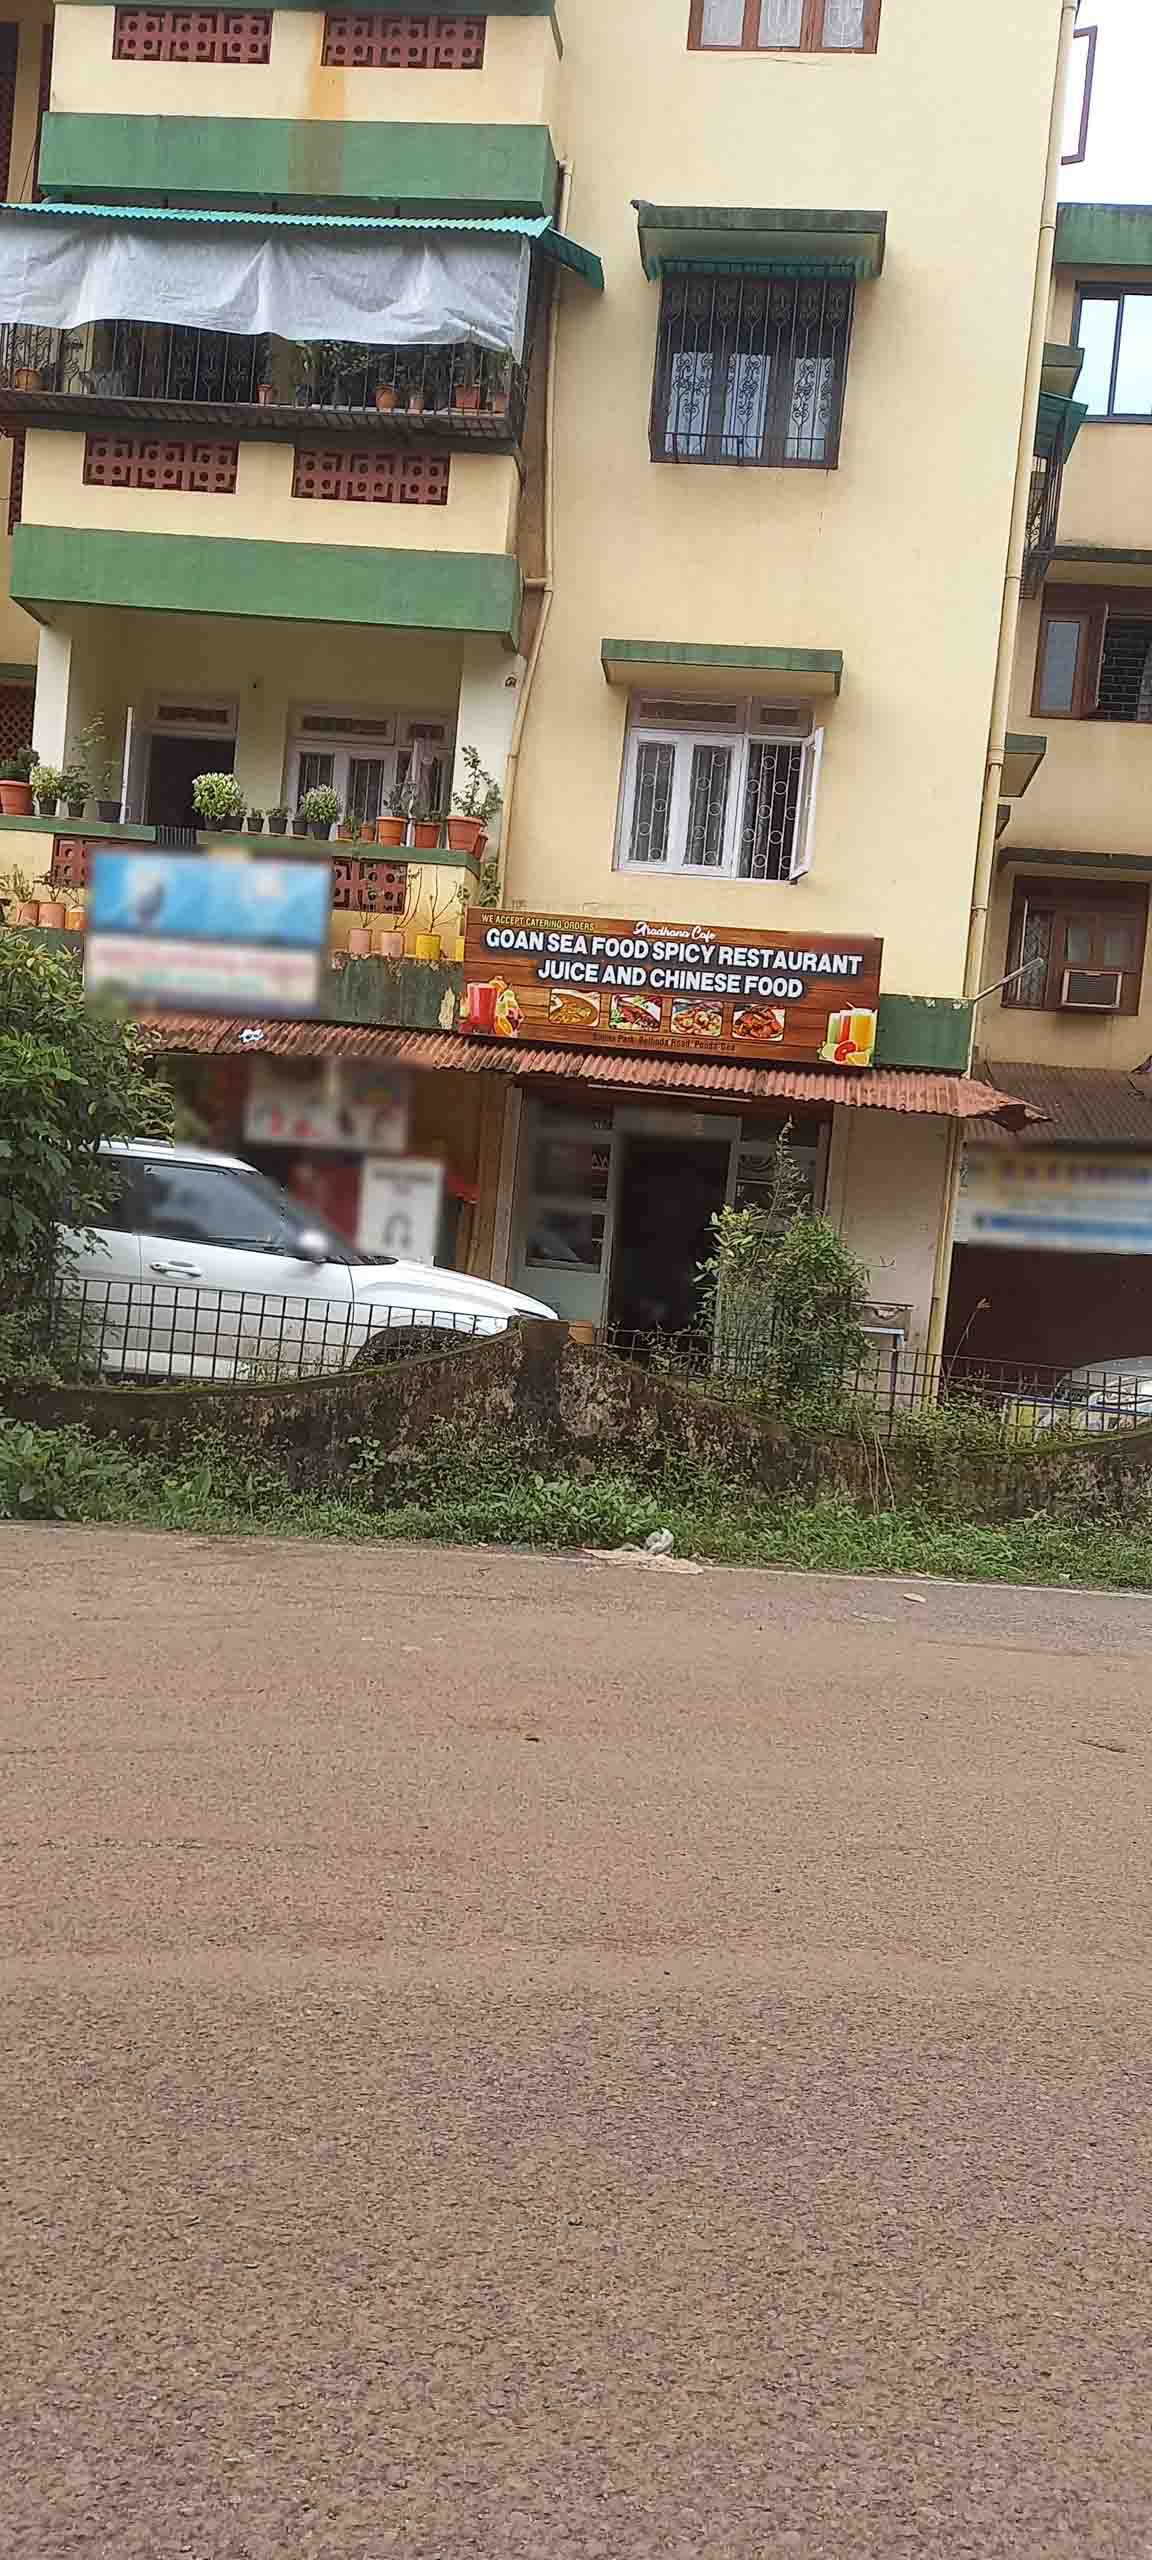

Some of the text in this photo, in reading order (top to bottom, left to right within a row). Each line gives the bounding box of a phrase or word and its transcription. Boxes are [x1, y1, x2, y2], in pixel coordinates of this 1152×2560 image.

[481, 914, 594, 931] WE ACCEPT CATERING ORDERS
[691, 925, 716, 942] Cafe
[486, 928, 862, 975] GOAN SEA FOOD SPICY RESTAURANT
[537, 960, 803, 998] JUICE AND CHINESE FOOD
